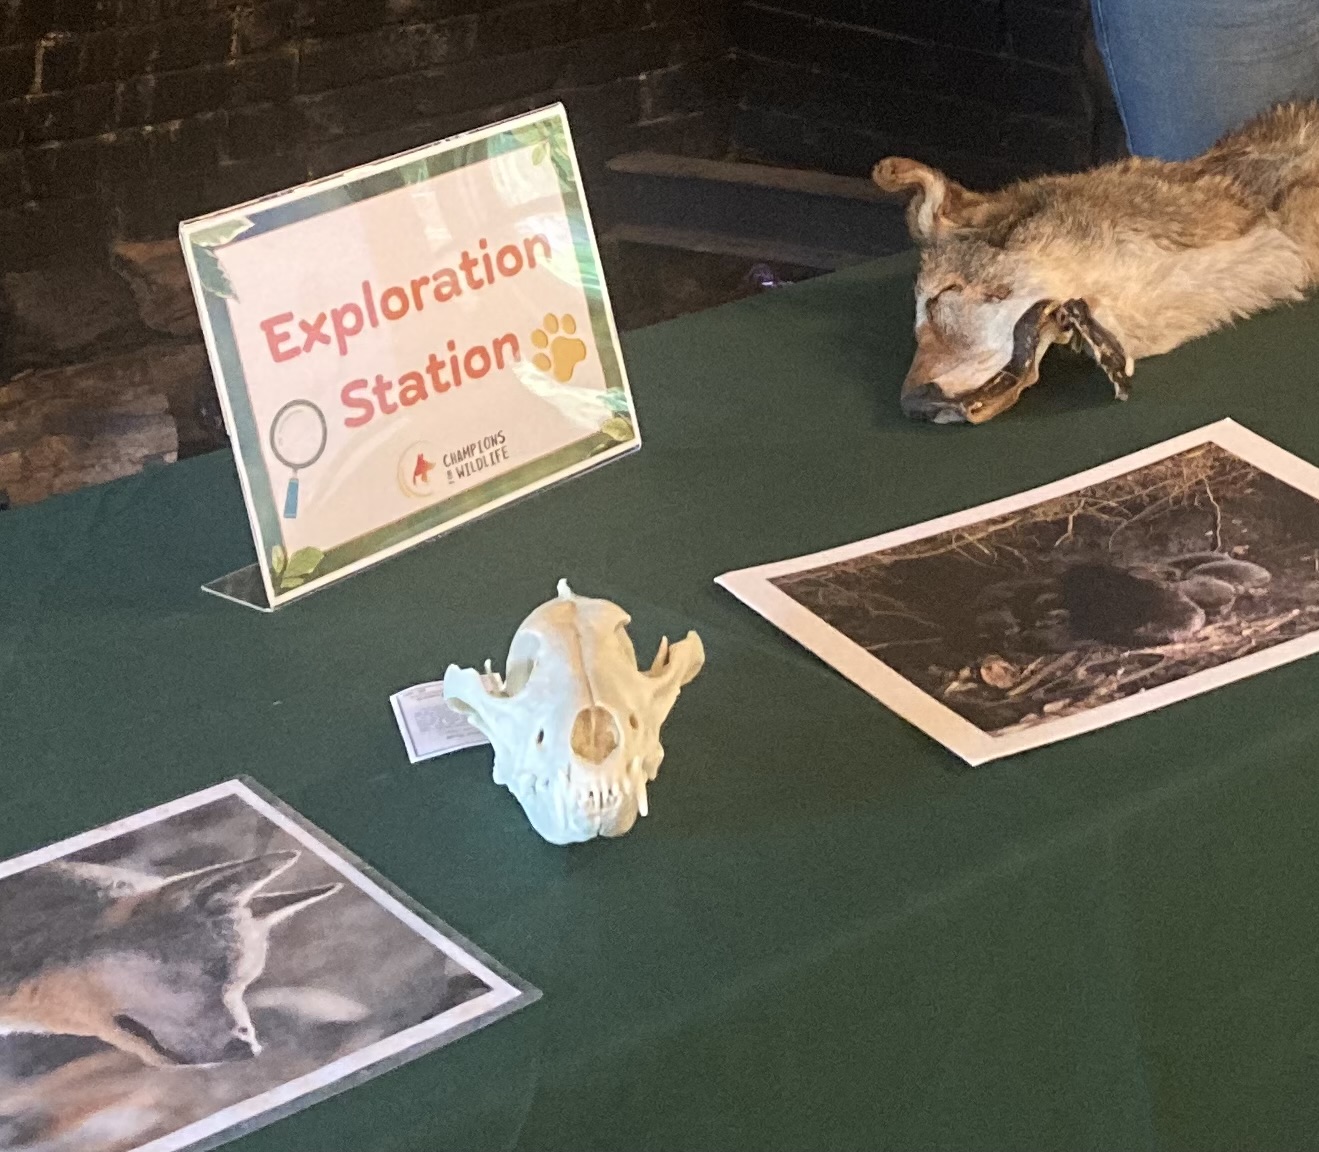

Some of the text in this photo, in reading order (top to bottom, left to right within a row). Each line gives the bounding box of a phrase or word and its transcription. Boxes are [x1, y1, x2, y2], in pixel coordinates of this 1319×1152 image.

[260, 232, 553, 363] Exploration
[339, 331, 523, 428] Station
[442, 429, 506, 468] CHAMPIONS
[455, 445, 510, 480] WILDLIFE
